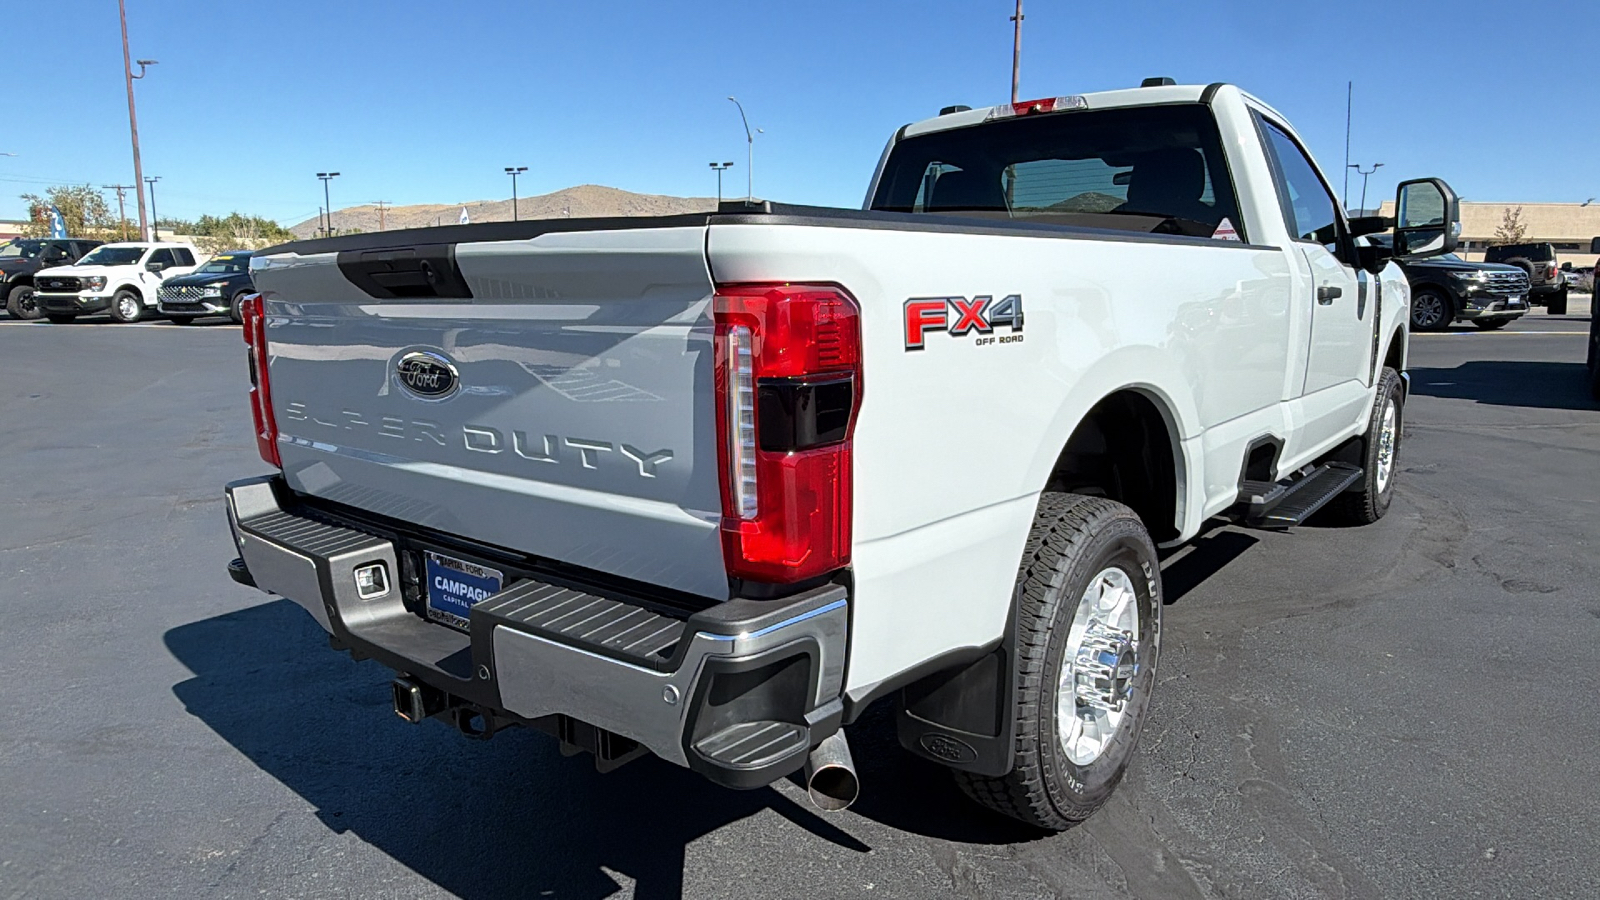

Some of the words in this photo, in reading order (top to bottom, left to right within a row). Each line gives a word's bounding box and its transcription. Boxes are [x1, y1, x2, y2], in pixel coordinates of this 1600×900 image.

[903, 294, 1024, 352] FX4
[975, 336, 996, 346] OFF
[999, 335, 1024, 345] ROAD
[407, 361, 440, 388] Ford
[286, 402, 447, 446] SUPER
[463, 425, 674, 478] DUTY
[465, 564, 484, 576] FORD
[434, 576, 495, 603] CAMPAGN
[443, 594, 469, 609] CAPITAL
